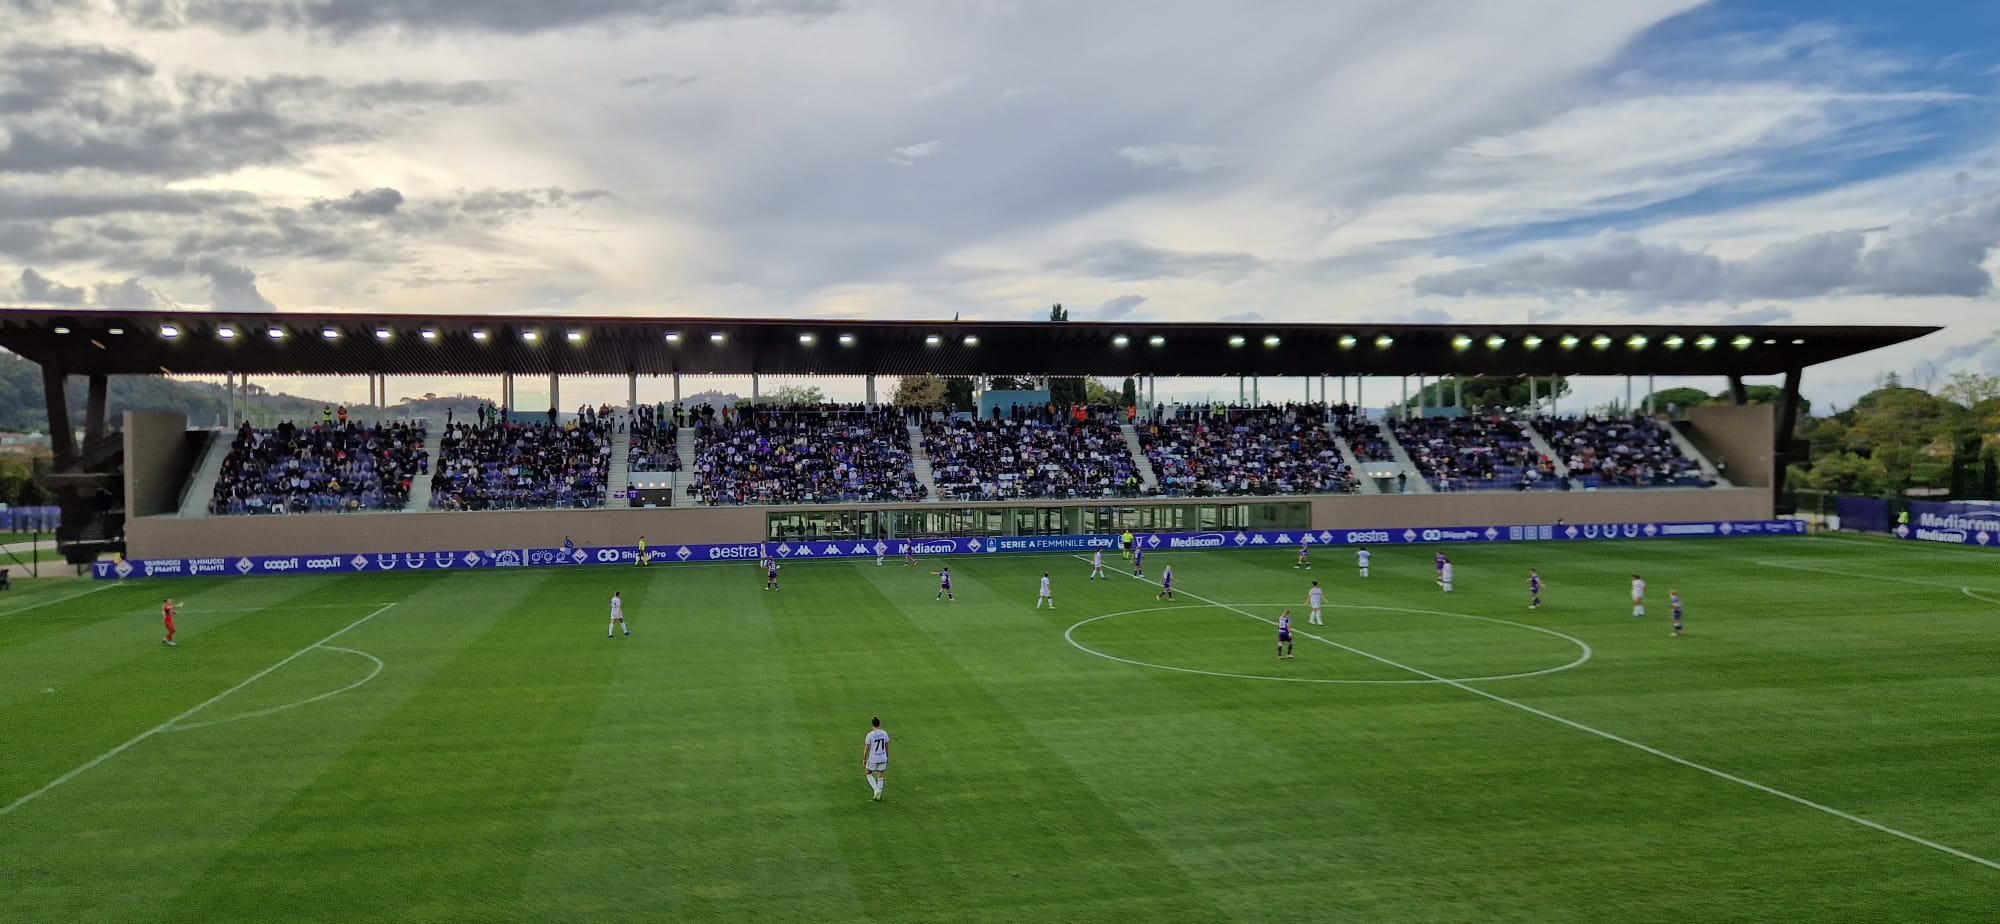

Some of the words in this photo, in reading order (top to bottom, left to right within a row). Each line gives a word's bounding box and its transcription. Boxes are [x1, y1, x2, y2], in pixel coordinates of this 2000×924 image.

[1171, 536, 1219, 547] Mediacom
[1916, 529, 1962, 543] Mediacom
[1001, 541, 1026, 549] SERIE
[1088, 537, 1113, 548] ebay
[874, 739, 884, 752] 71
